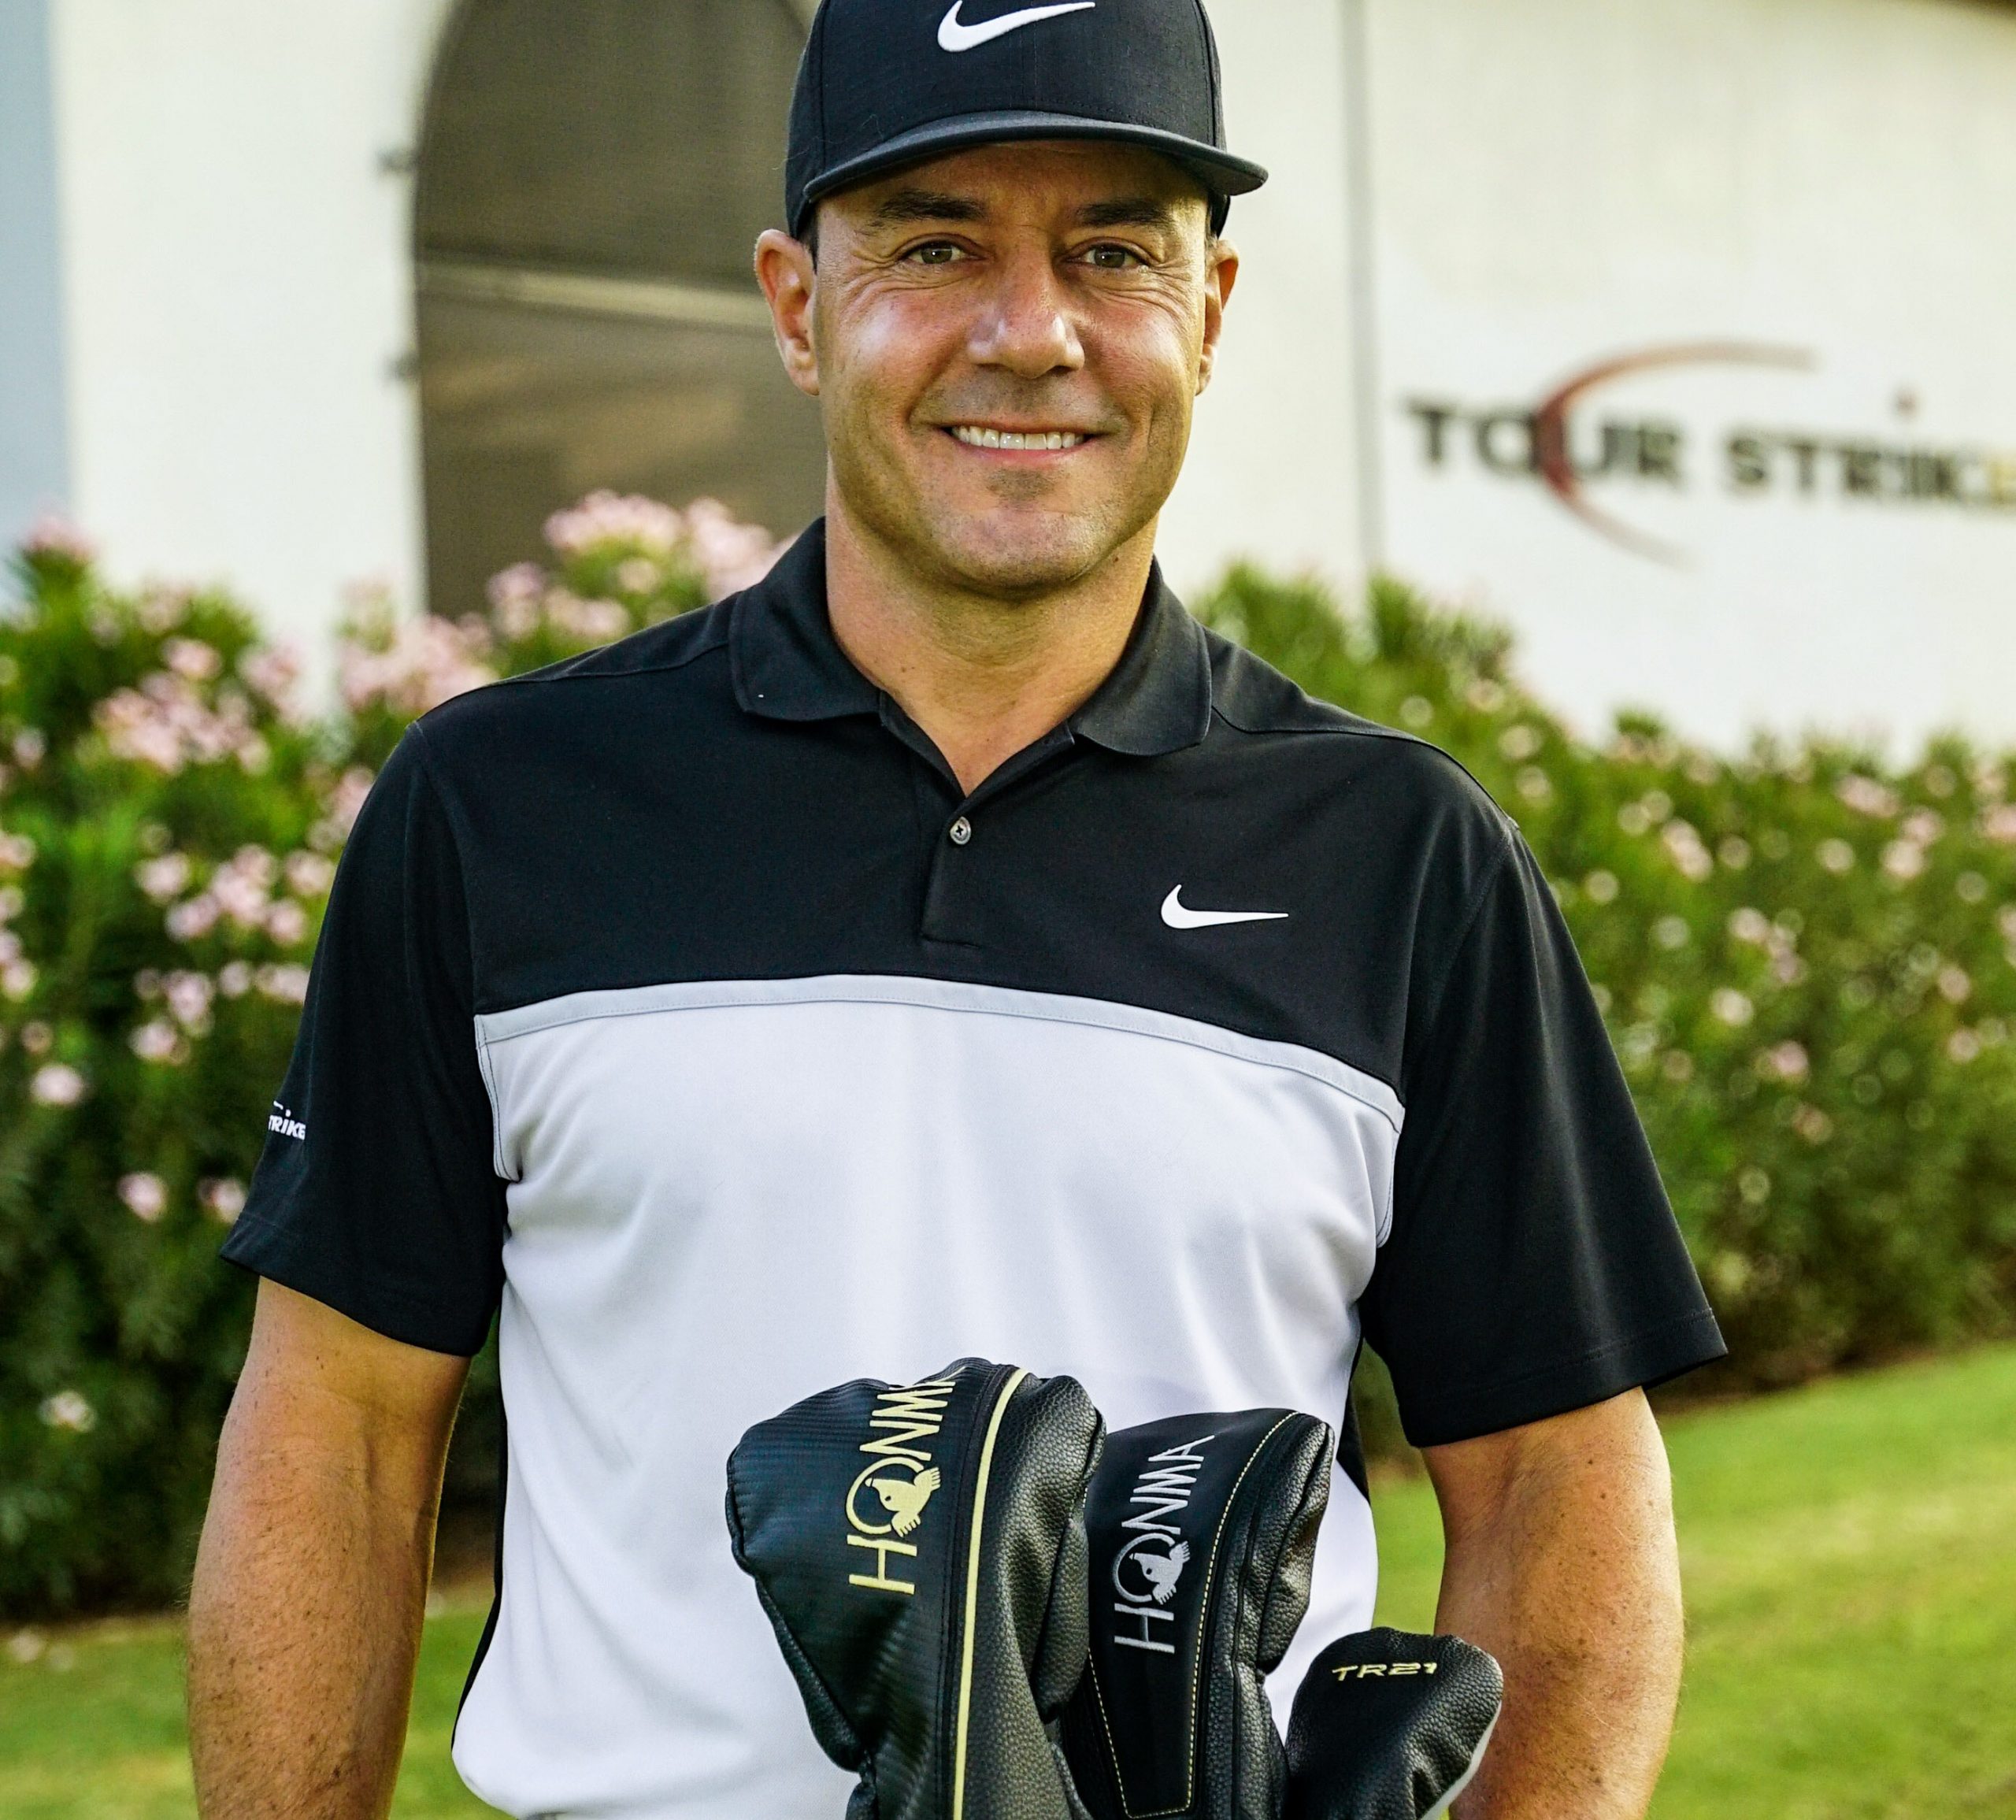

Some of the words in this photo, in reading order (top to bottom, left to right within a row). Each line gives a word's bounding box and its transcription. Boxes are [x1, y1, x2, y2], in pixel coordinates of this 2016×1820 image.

[1406, 396, 1685, 487] TOUR
[1112, 1434, 1215, 1655] HONMA
[1332, 1662, 1437, 1681] TR21
